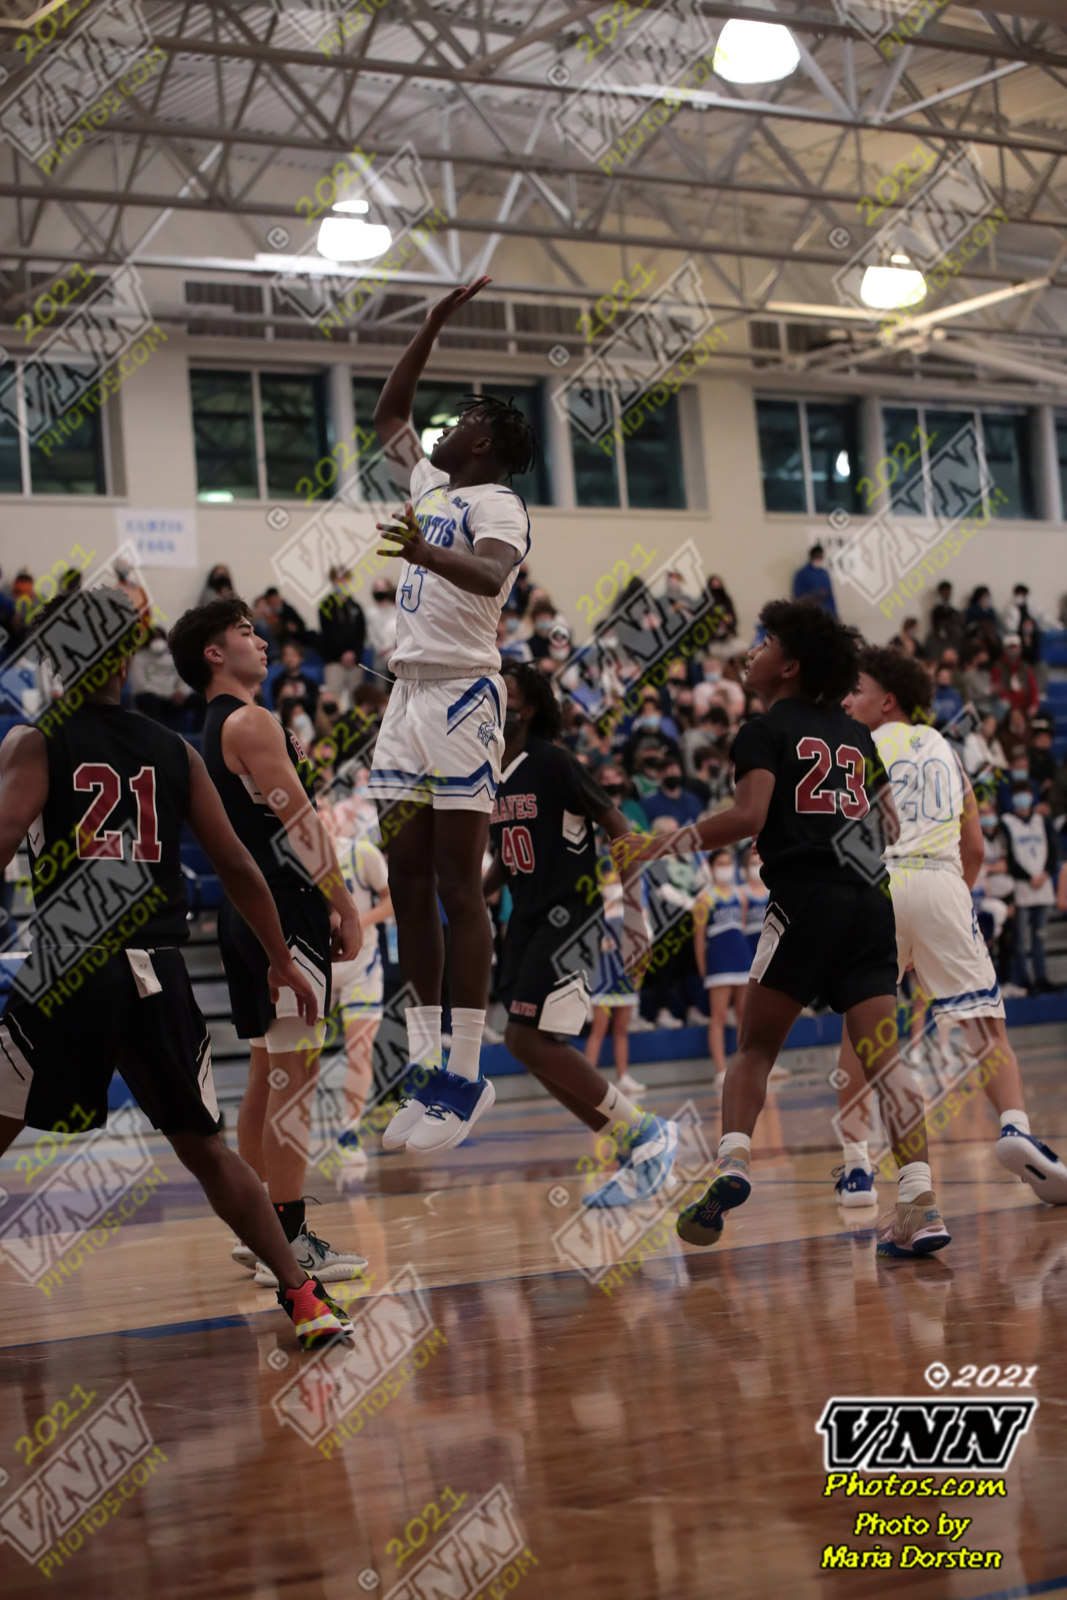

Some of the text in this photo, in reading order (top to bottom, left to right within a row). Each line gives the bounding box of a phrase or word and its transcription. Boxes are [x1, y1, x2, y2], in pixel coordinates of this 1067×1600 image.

[73, 762, 162, 862] 21
[795, 737, 870, 821] 23
[889, 758, 953, 823] 20
[502, 826, 535, 876] 40
